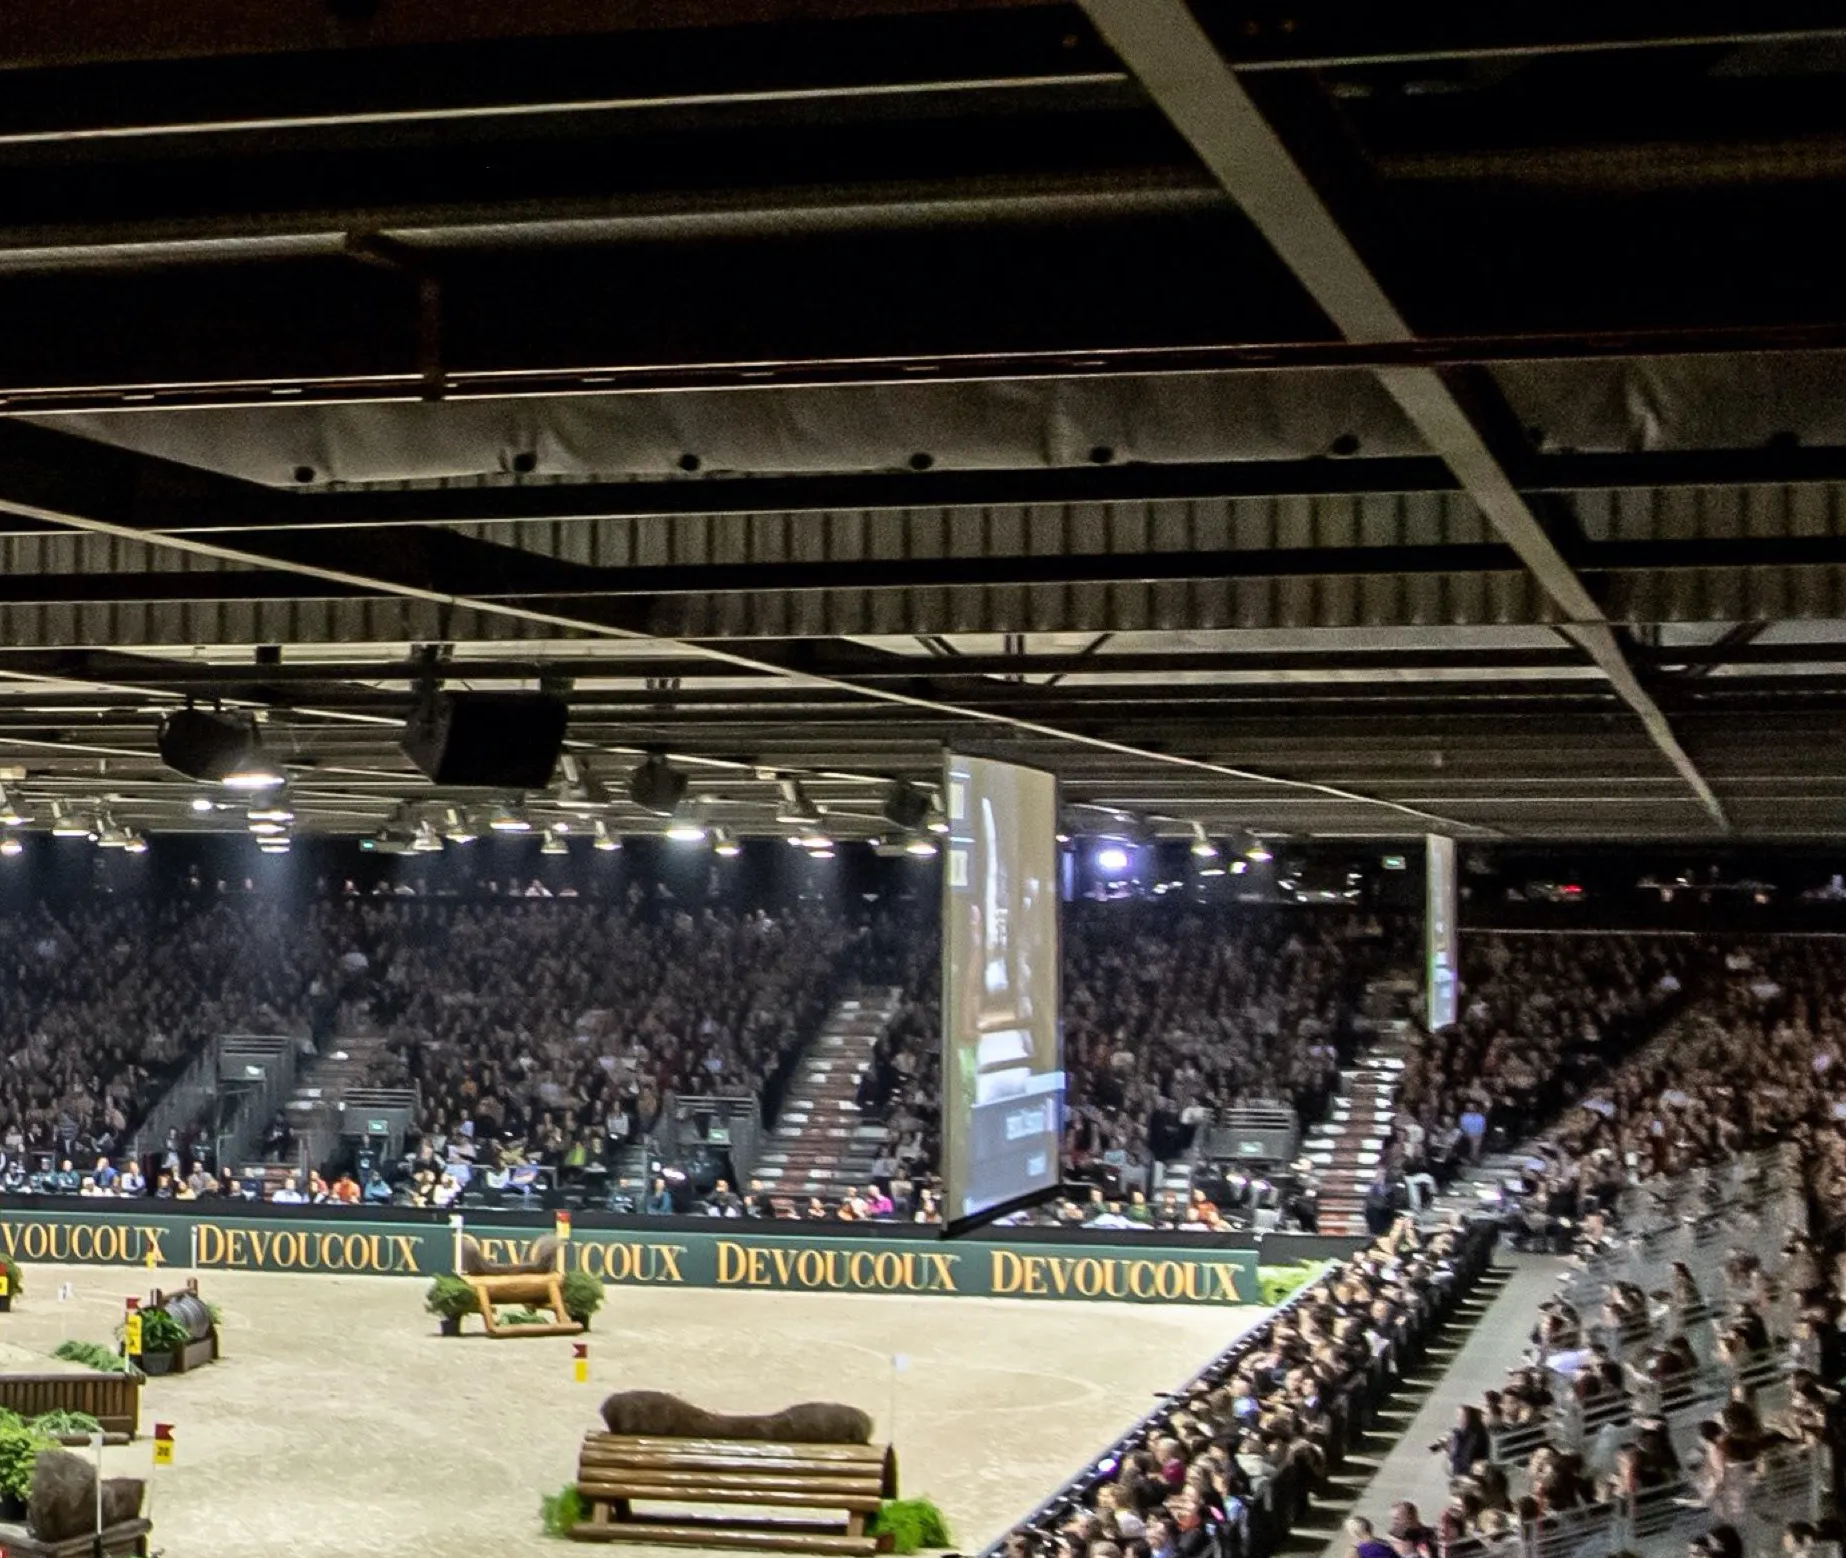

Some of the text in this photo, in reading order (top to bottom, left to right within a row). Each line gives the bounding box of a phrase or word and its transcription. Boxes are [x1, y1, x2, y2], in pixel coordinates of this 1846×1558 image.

[197, 1224, 422, 1272] DEVOUCOUX
[716, 1240, 959, 1292] DEVOUCOUX
[990, 1249, 1243, 1302] DEVOUCOUX
